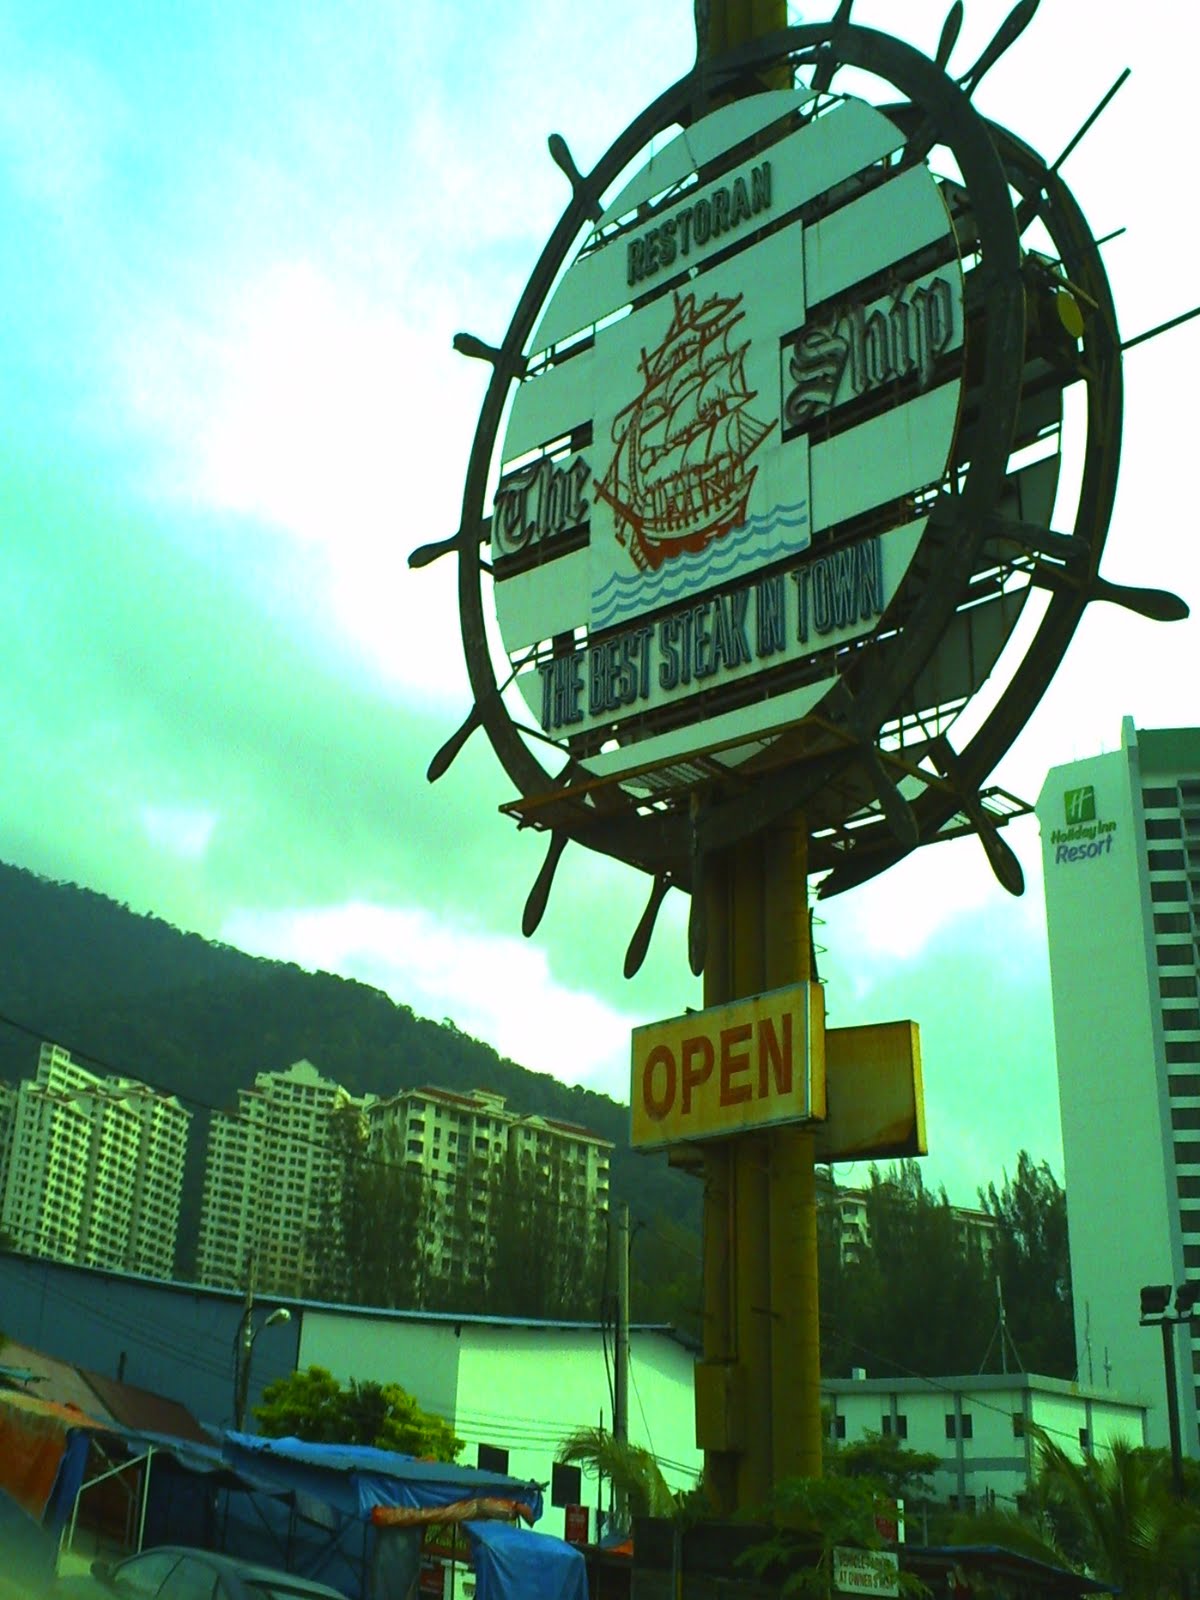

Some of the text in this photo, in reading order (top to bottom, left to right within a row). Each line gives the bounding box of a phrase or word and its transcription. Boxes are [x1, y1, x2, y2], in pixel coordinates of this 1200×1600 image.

[626, 160, 774, 287] RESTORAN
[493, 276, 954, 556] The Ship
[538, 535, 884, 732] THE BEST STEAK IN TOWN
[1051, 820, 1117, 844] Holiday Inn
[1055, 834, 1113, 865] Resort
[642, 1012, 793, 1122] OPEN
